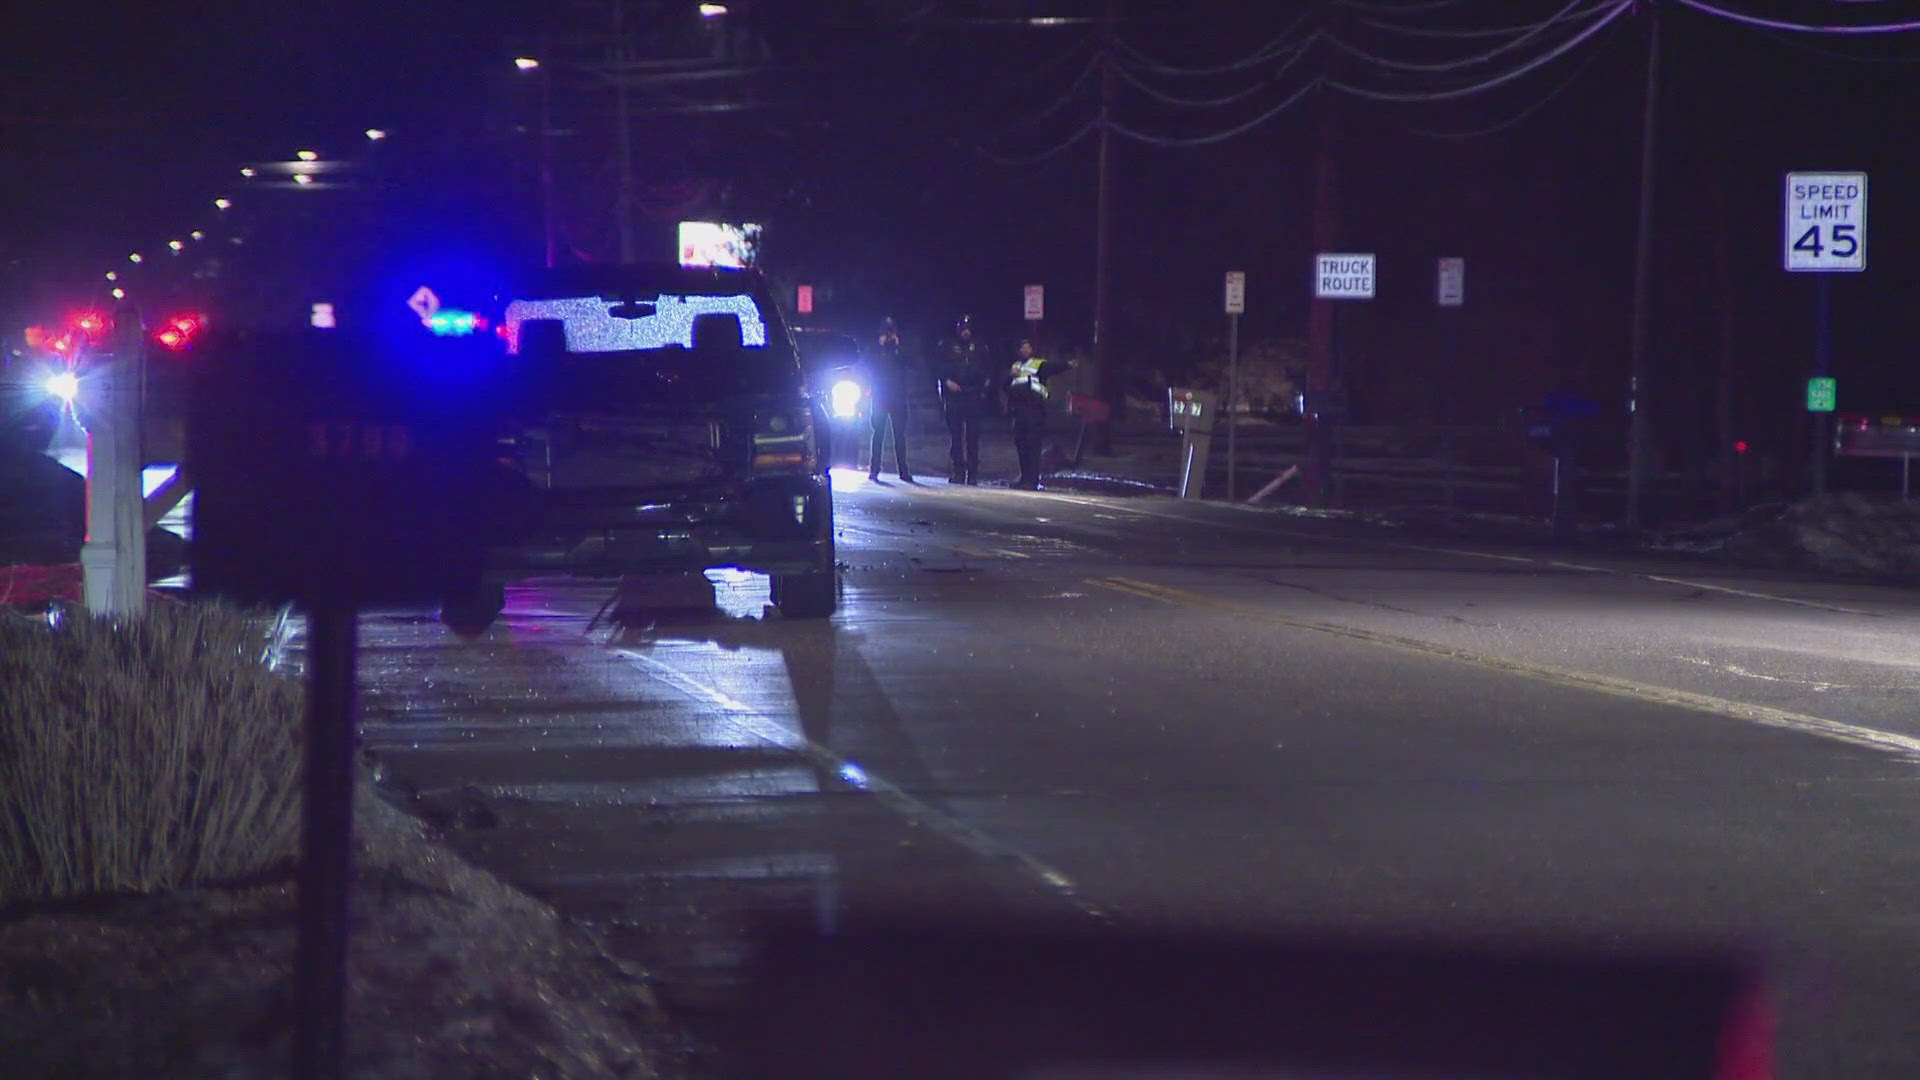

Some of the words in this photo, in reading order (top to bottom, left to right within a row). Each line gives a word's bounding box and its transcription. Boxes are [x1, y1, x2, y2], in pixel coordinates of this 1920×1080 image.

[1795, 185, 1859, 200] SPEED
[1800, 204, 1852, 220] LIMIT
[1793, 225, 1858, 258] 45
[1321, 260, 1370, 274] TRUCK
[1322, 277, 1370, 292] ROUTE
